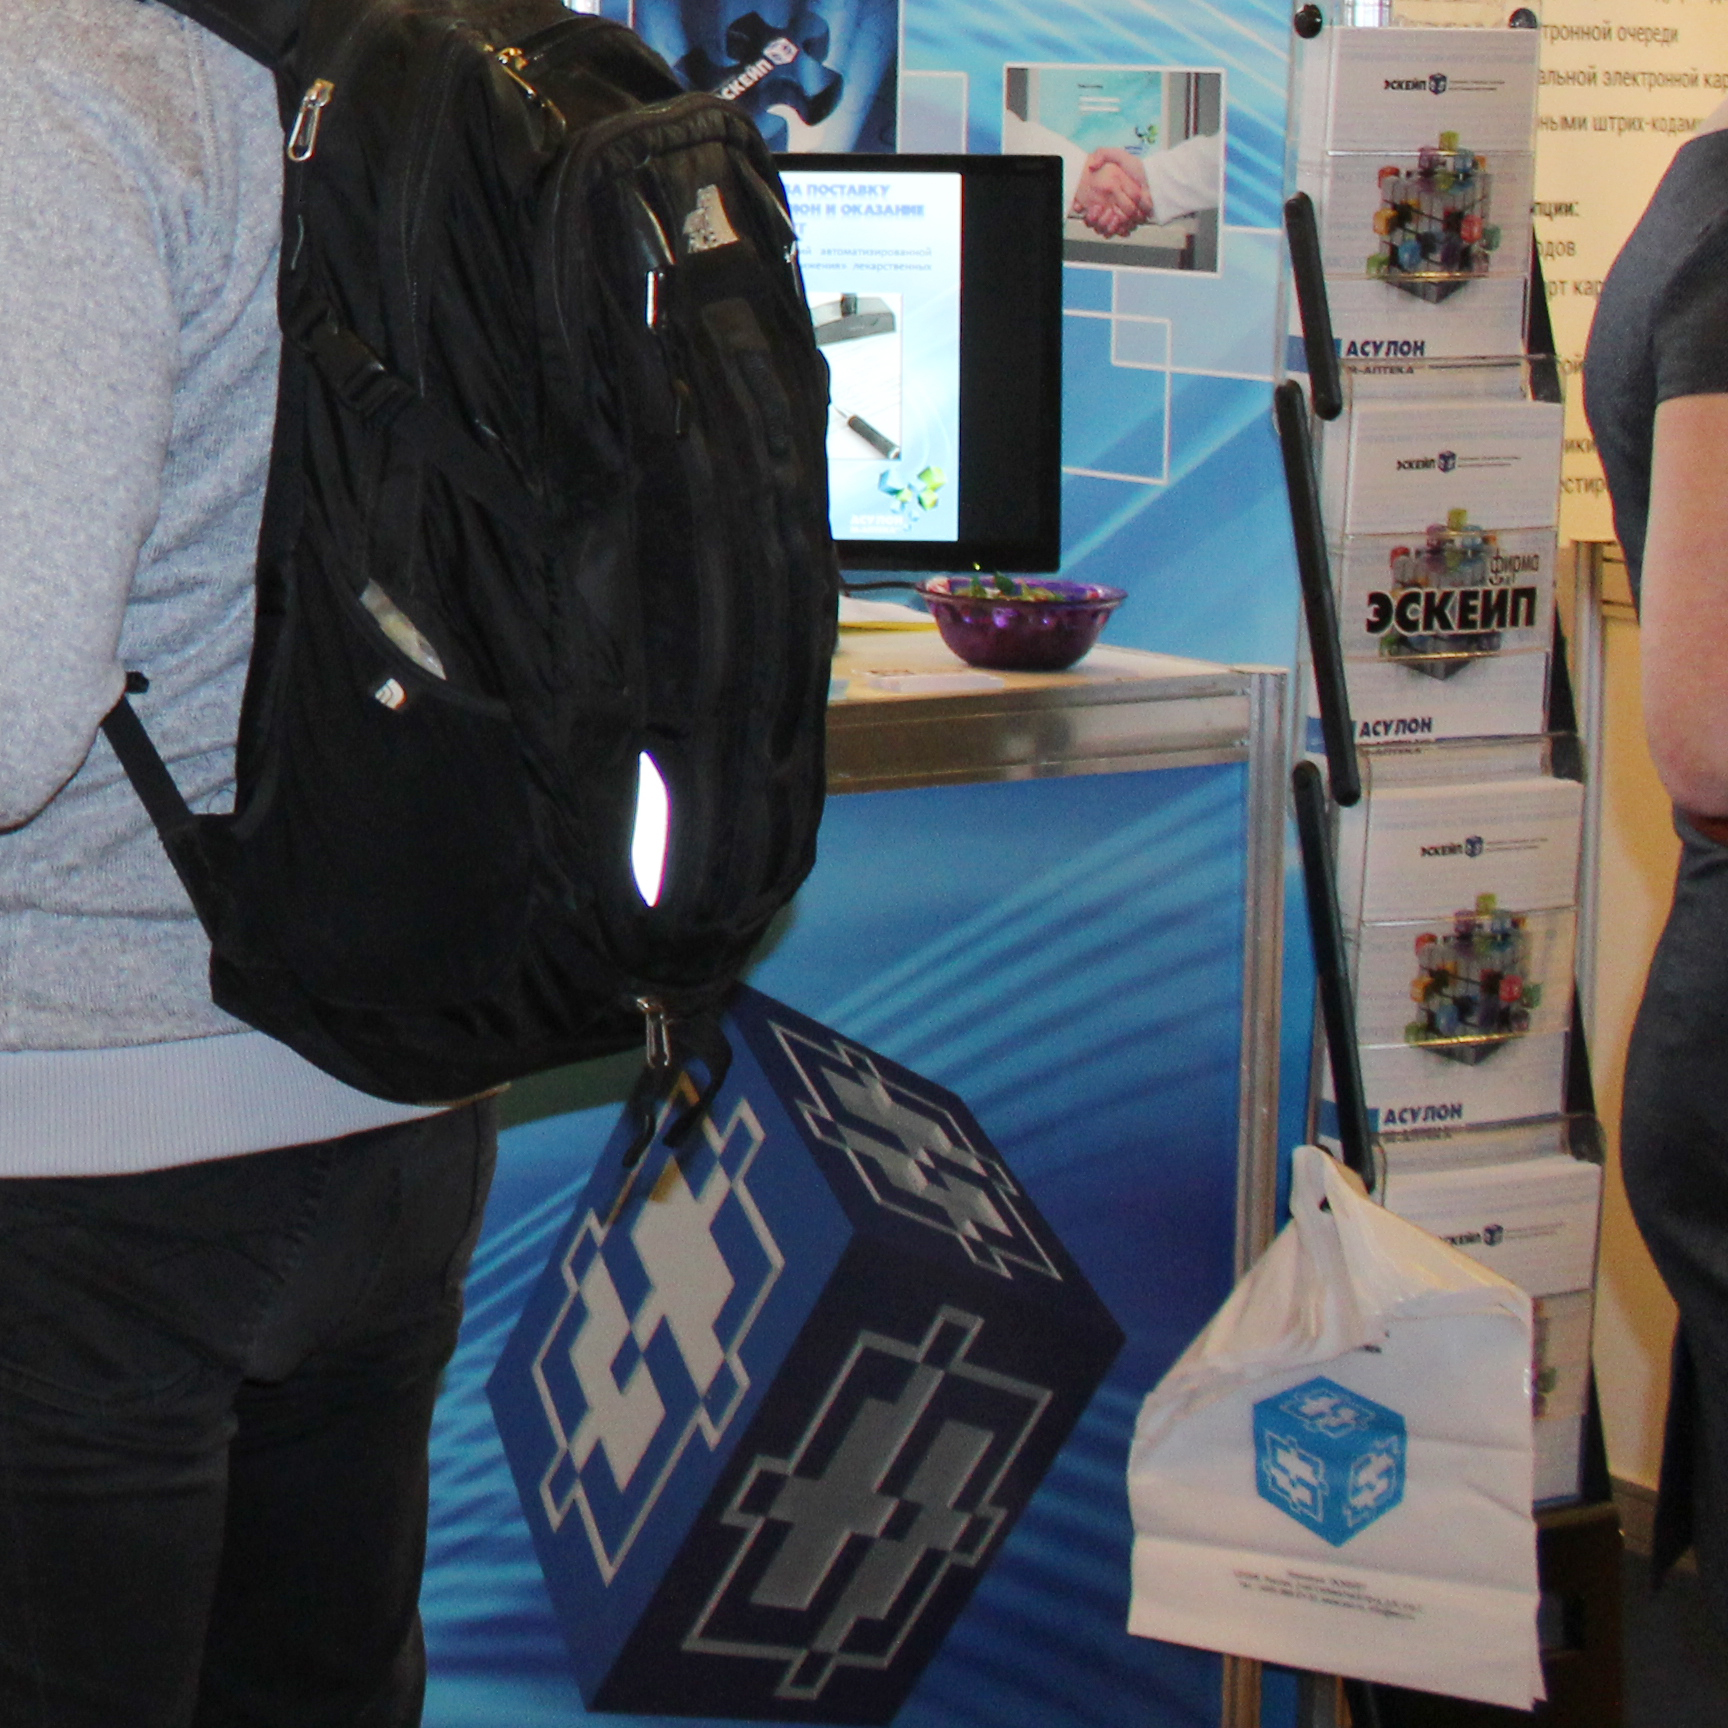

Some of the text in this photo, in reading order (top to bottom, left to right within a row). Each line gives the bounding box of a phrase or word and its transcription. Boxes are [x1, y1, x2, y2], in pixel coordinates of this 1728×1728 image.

[1346, 340, 1426, 357] АСУЛОН
[1360, 717, 1433, 738] АСУЛОН
[1384, 1103, 1463, 1125] АСУЛОН
